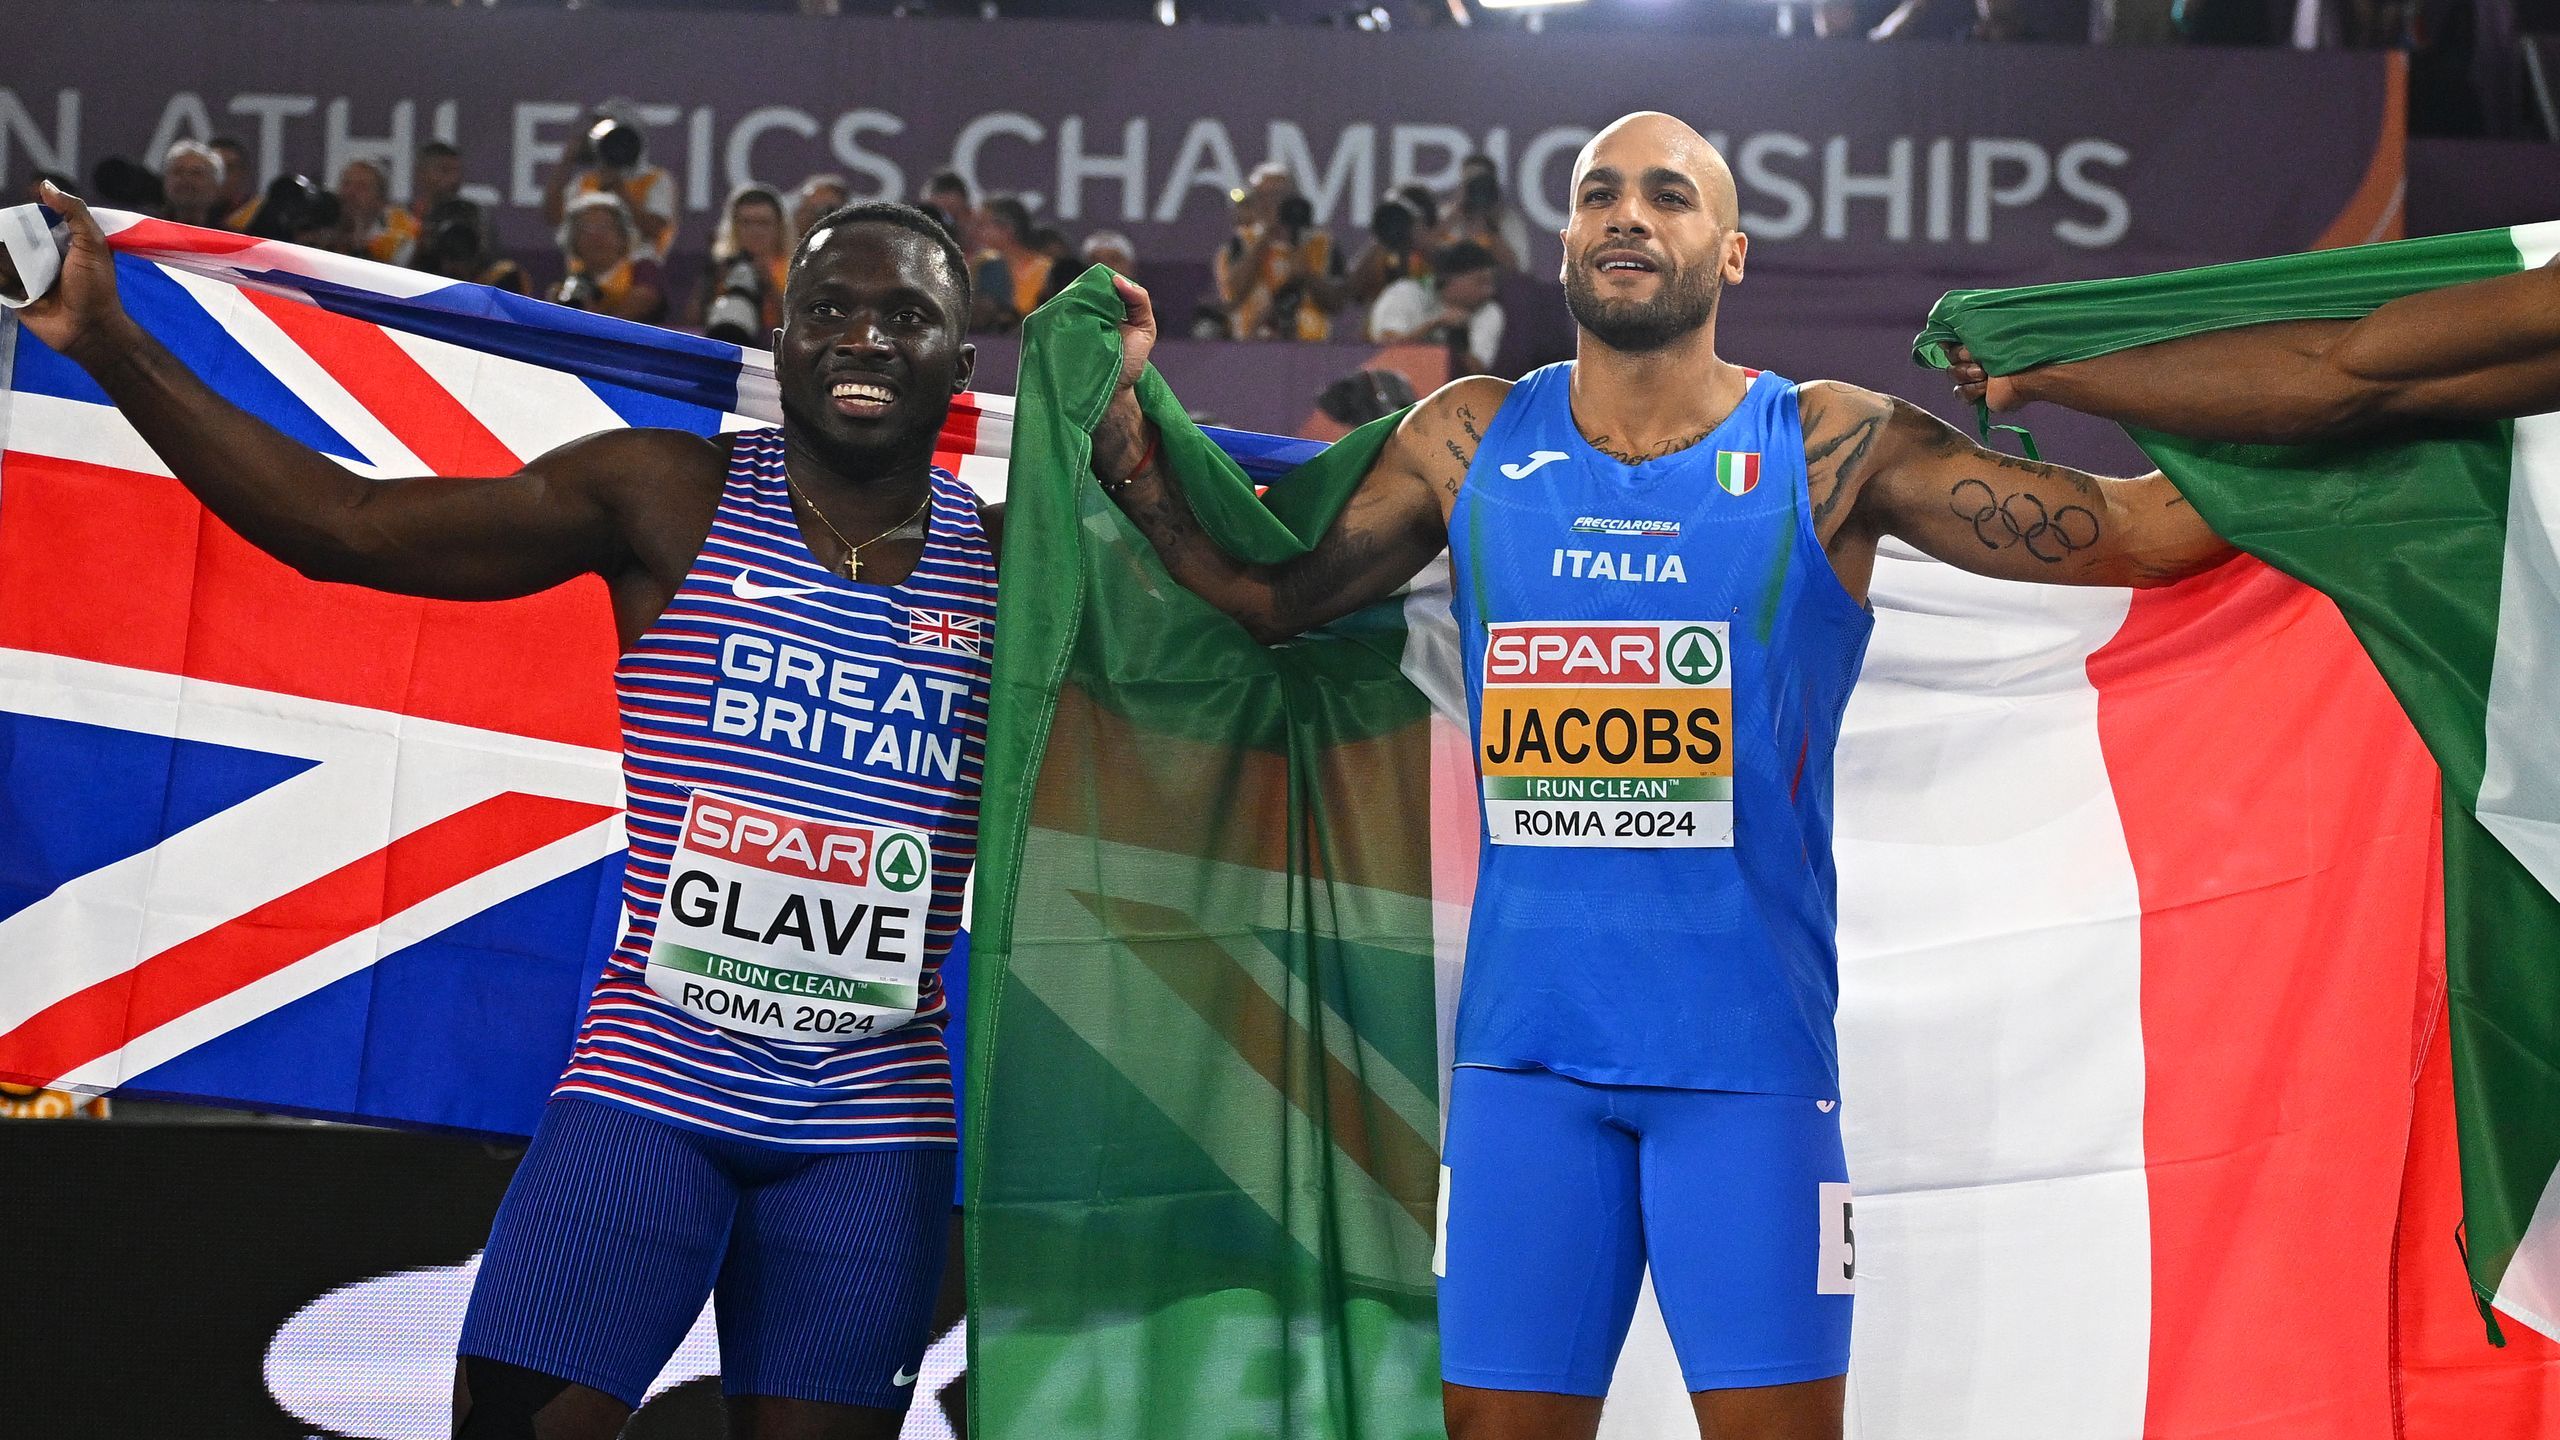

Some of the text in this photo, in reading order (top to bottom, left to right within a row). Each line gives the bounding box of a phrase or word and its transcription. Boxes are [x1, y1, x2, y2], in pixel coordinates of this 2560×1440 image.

[951, 110, 2131, 247] CHAMPIOSHIPS
[1573, 516, 1681, 532] FRECCIAROSSA
[1551, 548, 1688, 583] ITALIA
[721, 632, 970, 725] GREAT
[1491, 635, 1655, 675] SPAR
[712, 687, 962, 782] BRITAIN
[1486, 707, 1722, 765] JACOBS
[1526, 779, 1532, 798] I
[1536, 779, 1585, 798] RUN
[690, 804, 867, 878] SPAR
[1514, 809, 1697, 837] ROMA 2024
[670, 869, 910, 963] GLAVE
[706, 956, 714, 974] I
[718, 958, 770, 988] RUN
[682, 982, 875, 1034] ROMA 2024
[1843, 1202, 1855, 1280] 5
